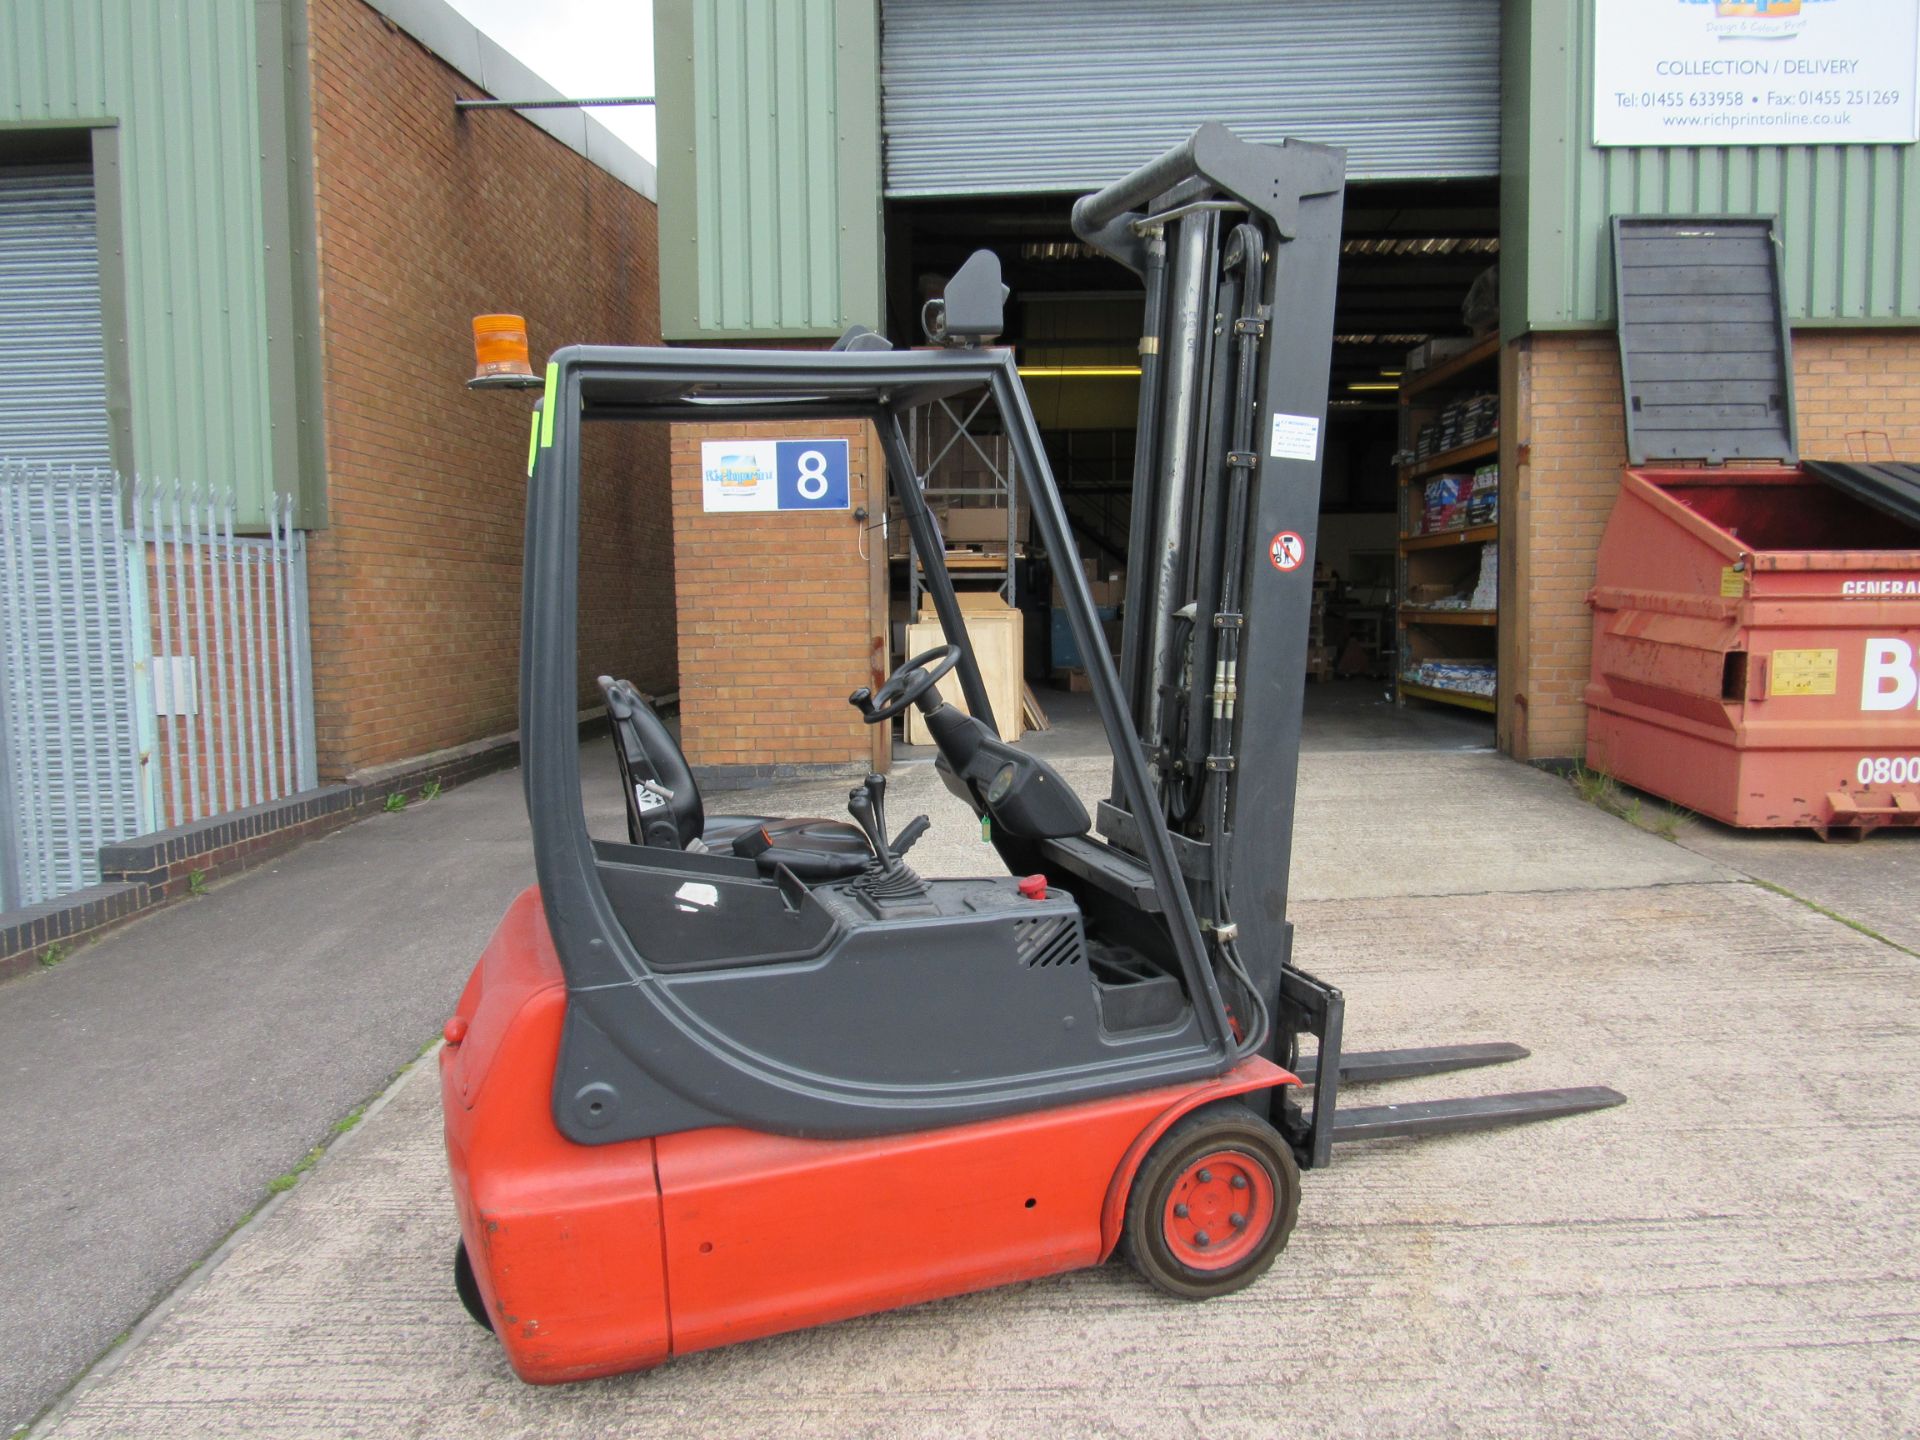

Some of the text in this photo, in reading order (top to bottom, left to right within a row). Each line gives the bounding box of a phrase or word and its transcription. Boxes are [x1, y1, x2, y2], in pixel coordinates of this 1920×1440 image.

[1656, 60, 1769, 76] COLLECTION
[1784, 59, 1859, 75] DELIVERY
[1615, 90, 1900, 107] Tel: 01455 633958 Fax: 01455 251269
[1663, 112, 1851, 130] www.richprintonline.co.uk
[797, 450, 828, 500] 8
[1842, 580, 1920, 597] GENERA
[1860, 638, 1920, 711] B
[1857, 757, 1920, 784] 0800
